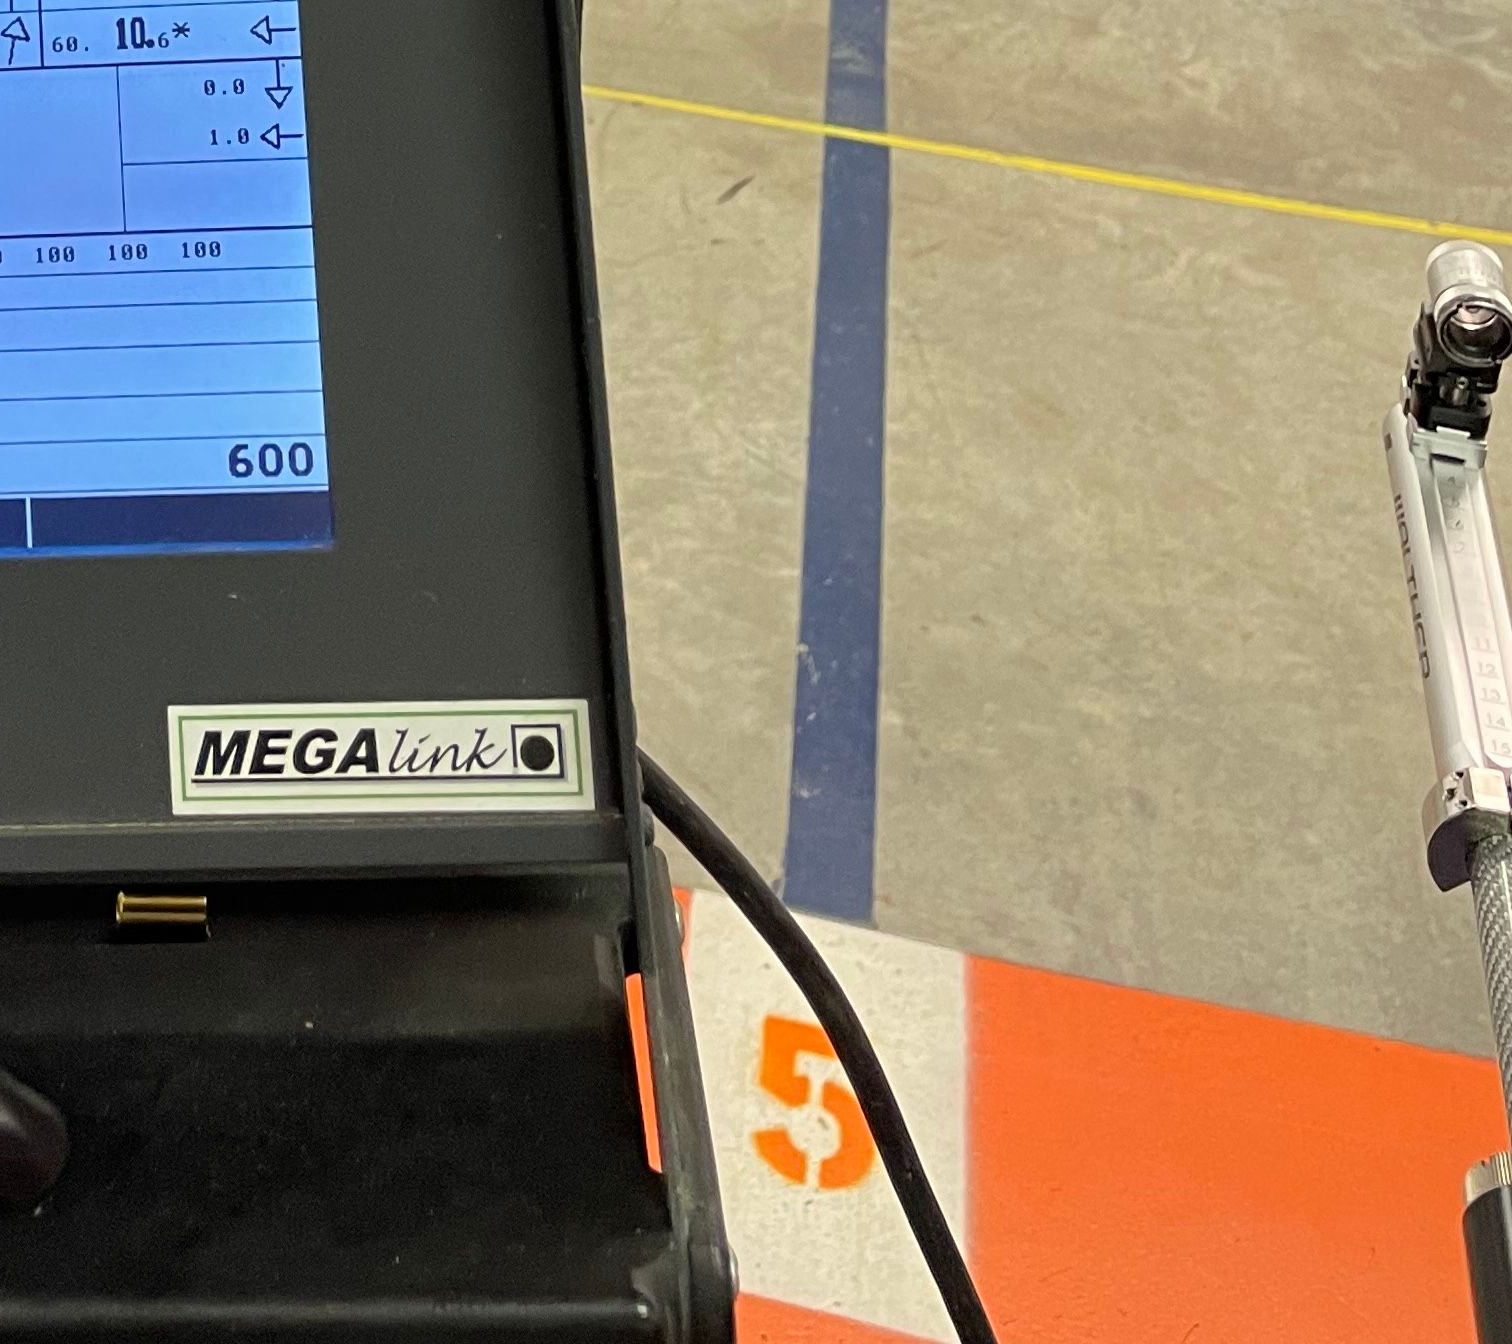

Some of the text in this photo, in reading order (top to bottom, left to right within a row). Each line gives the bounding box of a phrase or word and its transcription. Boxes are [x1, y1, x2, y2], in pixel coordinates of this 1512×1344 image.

[52, 36, 89, 53] 60.
[203, 78, 245, 96] 0.0
[210, 127, 250, 146] 1.0
[36, 246, 75, 264] 100
[109, 243, 148, 261] 100
[182, 240, 221, 259] 100
[228, 442, 314, 479] 600
[751, 1014, 876, 1190] 5
